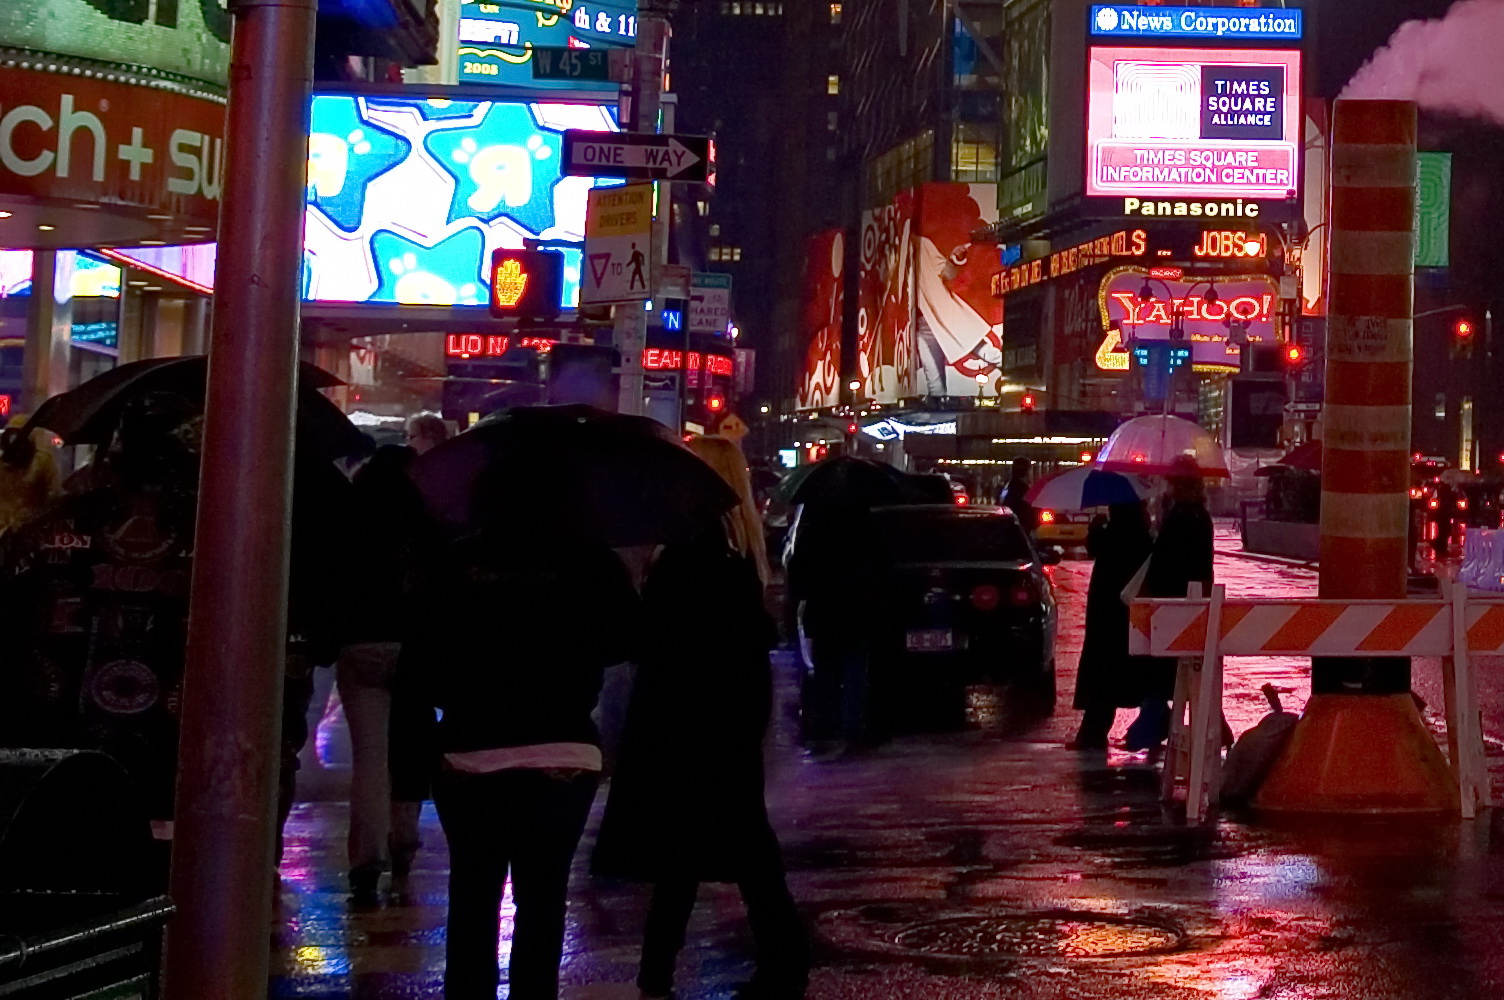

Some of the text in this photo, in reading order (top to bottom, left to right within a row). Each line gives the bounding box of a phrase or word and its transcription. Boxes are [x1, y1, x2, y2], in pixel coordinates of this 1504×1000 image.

[1121, 10, 1297, 35] News Corporation
[538, 54, 602, 76] W 45 ST
[1215, 80, 1270, 95] TIMES
[1208, 97, 1276, 112] SQUARE
[1211, 114, 1272, 126] ALLIANCE
[583, 145, 686, 167] ONE WAY
[1133, 150, 1259, 167] TIMES SQUARE
[1102, 166, 1289, 184] INFORMATION CENTER
[597, 191, 645, 206] ATTENTION
[1124, 198, 1259, 217] Panasonic
[599, 211, 637, 228] DRIVERS
[611, 262, 622, 276] TO
[1111, 292, 1272, 324] YAHOO!
